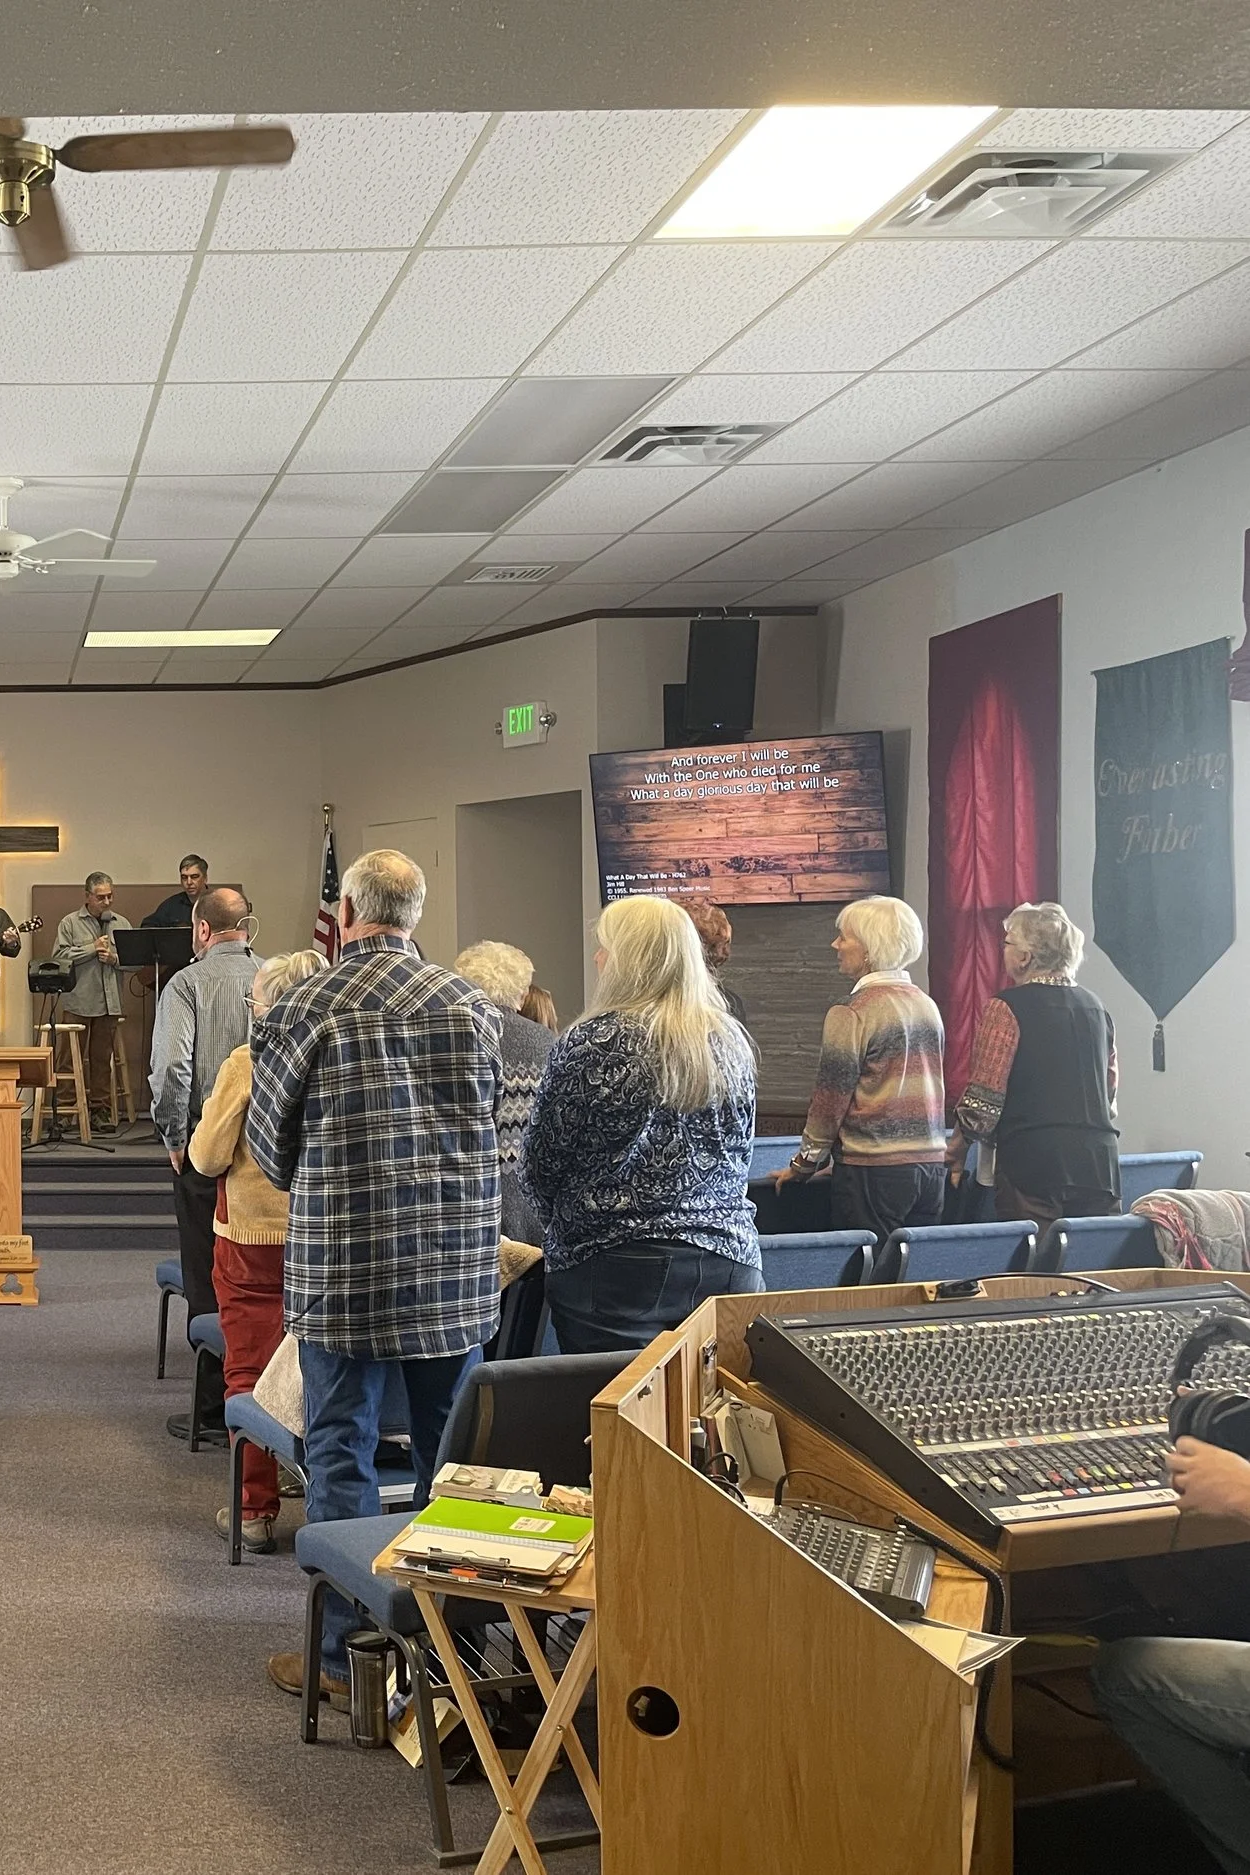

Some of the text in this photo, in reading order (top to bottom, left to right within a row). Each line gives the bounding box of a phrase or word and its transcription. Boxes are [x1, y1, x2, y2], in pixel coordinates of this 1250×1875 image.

[509, 704, 534, 735] EXIT
[671, 748, 789, 768] And forever I will be
[644, 763, 821, 784] With the One who died for me
[630, 776, 840, 801] What a day glorious day that will be
